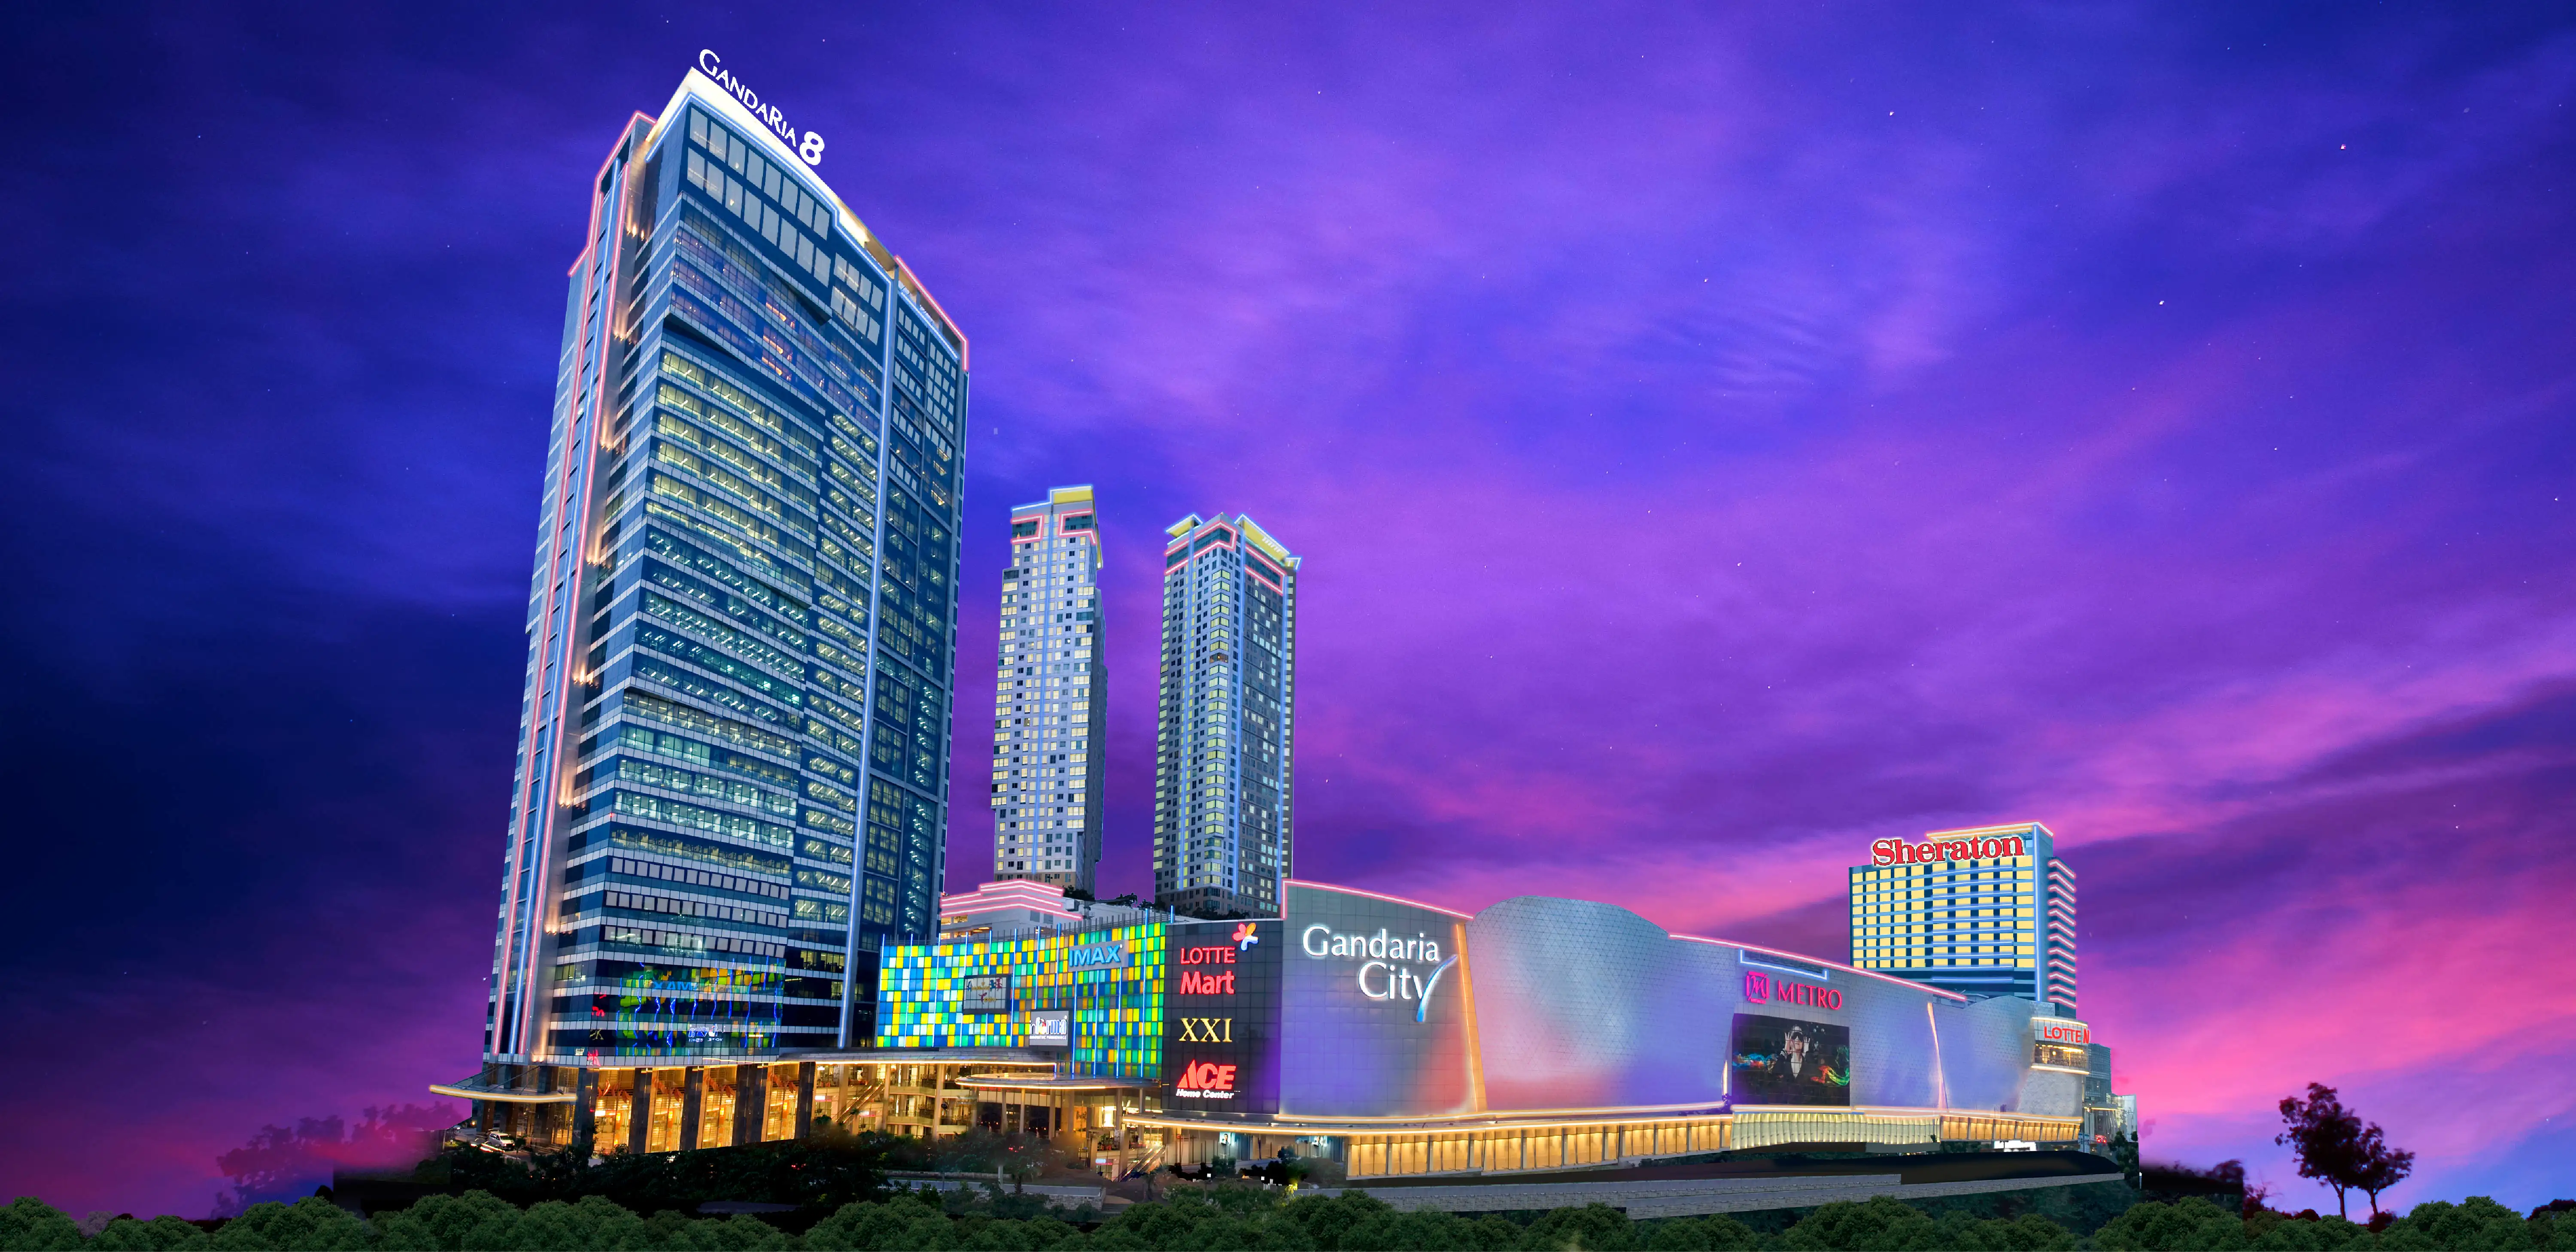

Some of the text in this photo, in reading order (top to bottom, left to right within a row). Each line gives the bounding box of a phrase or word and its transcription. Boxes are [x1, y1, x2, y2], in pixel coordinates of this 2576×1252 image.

[699, 49, 825, 166] GANDARIA 8
[1873, 836, 2024, 866] Sheraton
[1069, 945, 1121, 967] IMAX
[1181, 946, 1236, 965] LOTTE
[1303, 925, 1439, 962] Gandaria
[1180, 970, 1235, 995] Mart
[1358, 954, 1457, 1022] City
[1777, 979, 1842, 1010] METRO
[1179, 1017, 1233, 1043] XXI
[1177, 1058, 1236, 1090] ACE
[1176, 1088, 1234, 1099] Home Center
